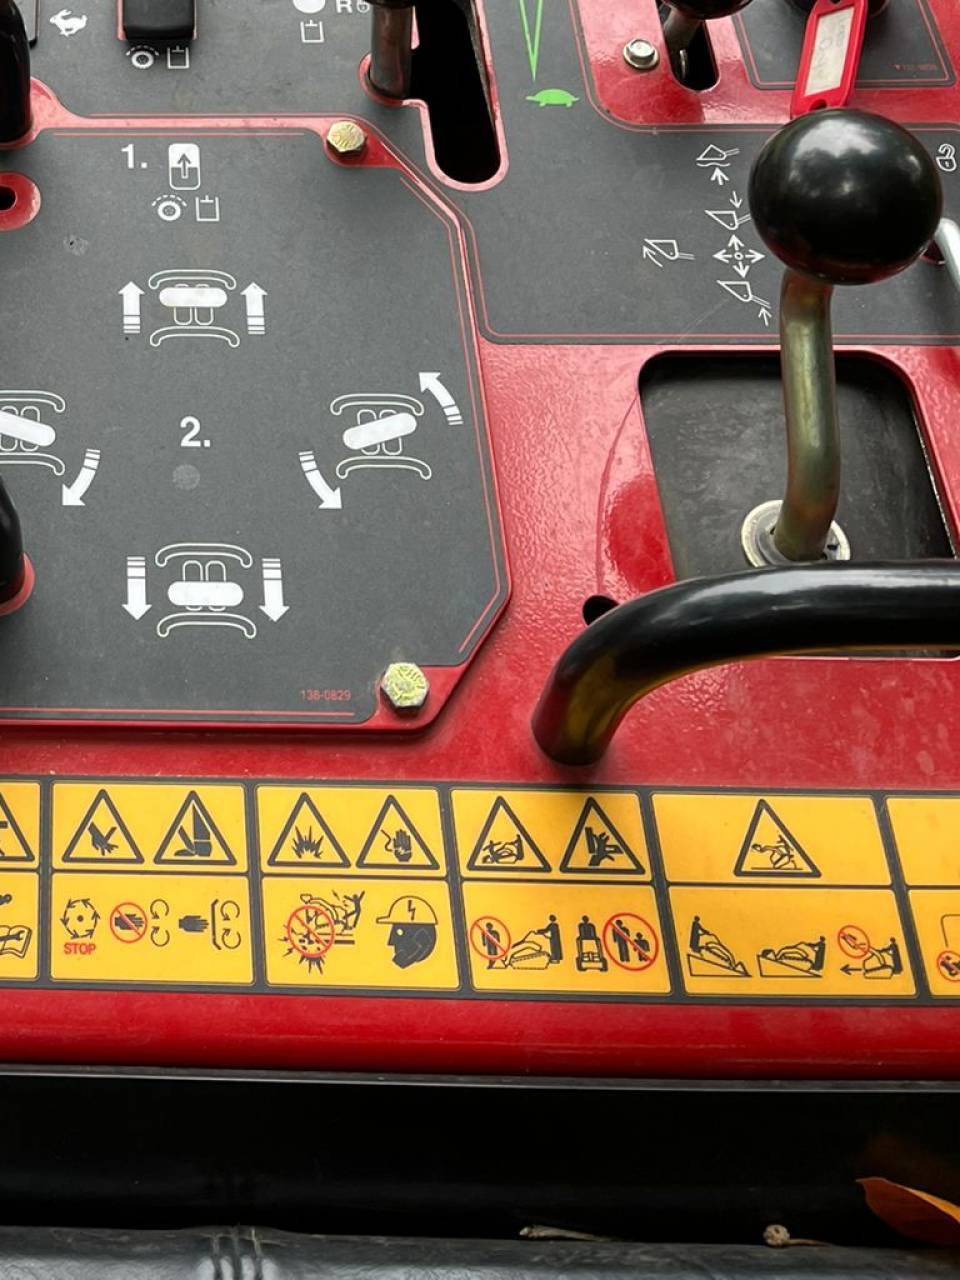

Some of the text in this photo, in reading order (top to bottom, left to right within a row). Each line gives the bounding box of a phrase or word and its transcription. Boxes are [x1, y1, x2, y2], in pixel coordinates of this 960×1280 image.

[121, 143, 148, 169] 1.
[180, 415, 211, 448] 2.
[63, 942, 97, 956] STOP
